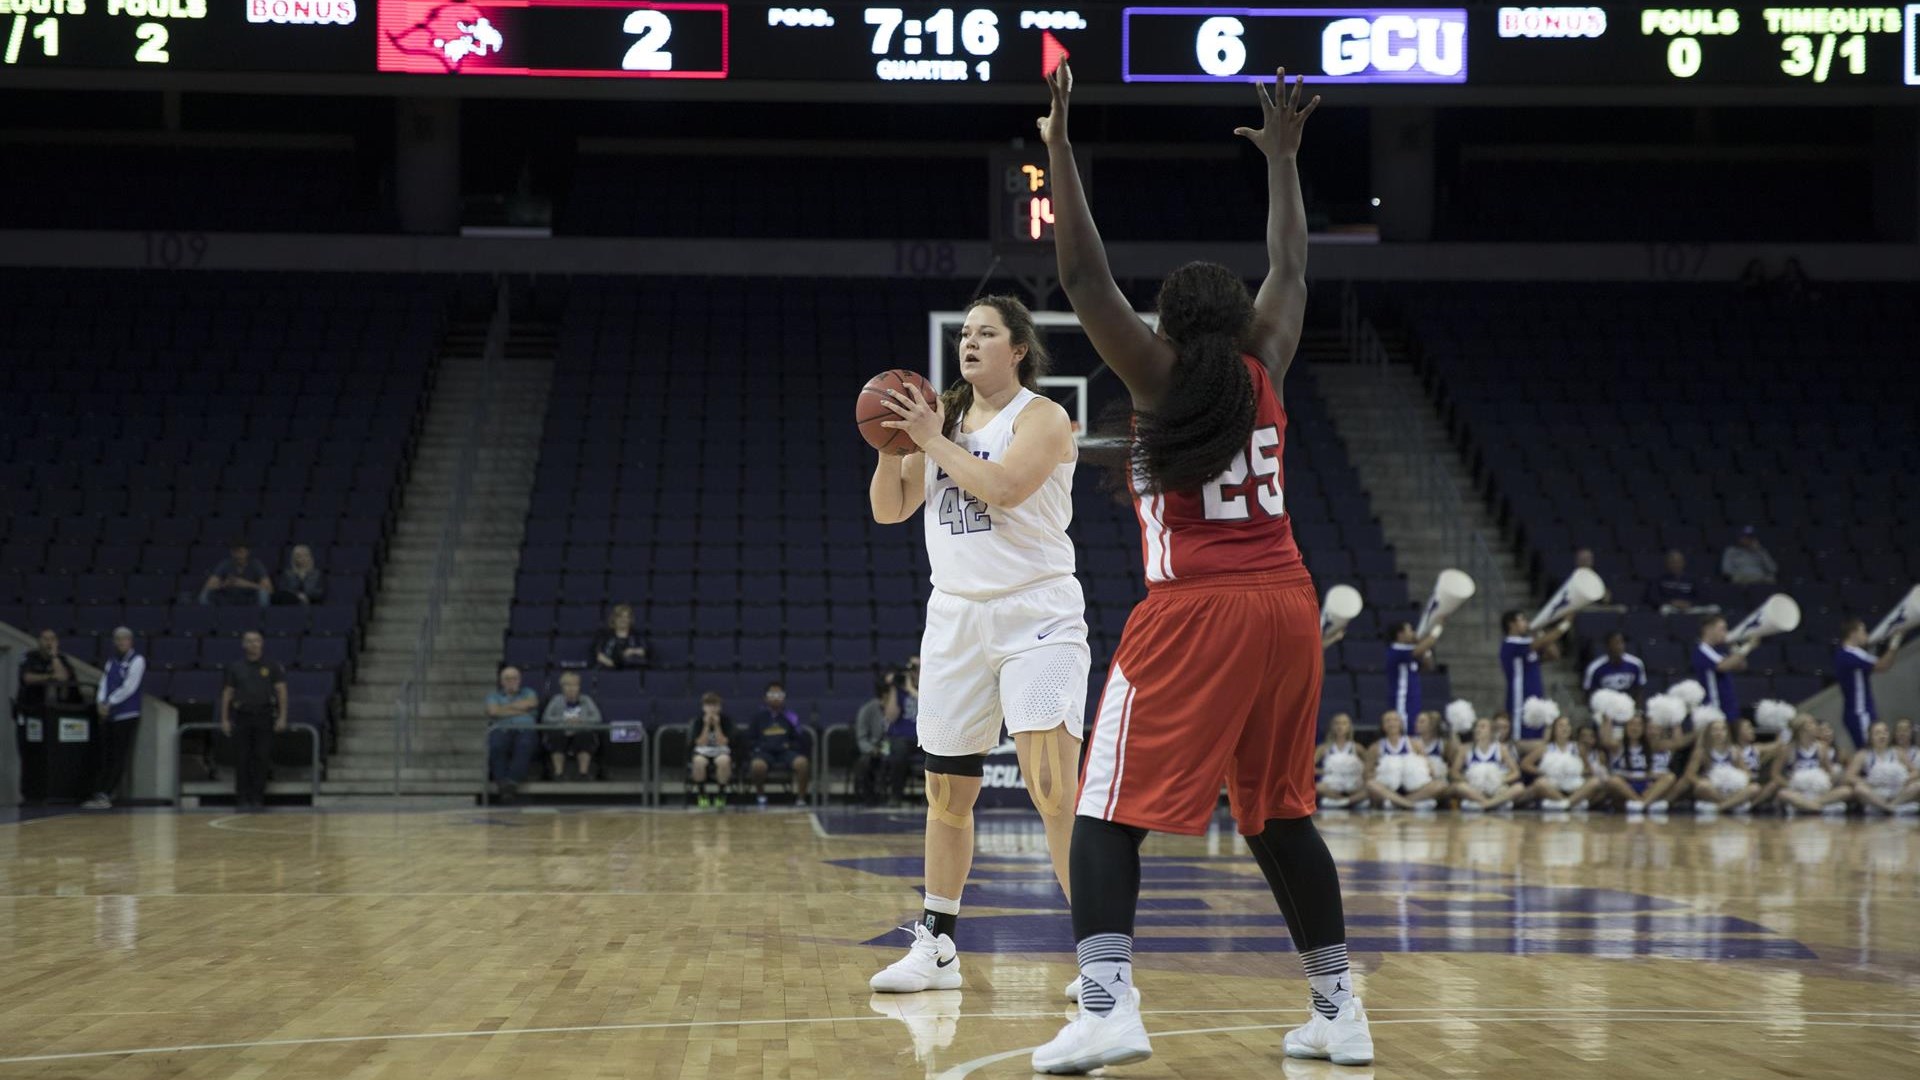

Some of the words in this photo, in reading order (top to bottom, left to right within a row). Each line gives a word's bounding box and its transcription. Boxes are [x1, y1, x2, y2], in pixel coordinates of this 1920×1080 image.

[247, 0, 356, 25] BONUS
[865, 8, 999, 55] 7:16
[1498, 7, 1607, 38] BONUS
[1641, 9, 1740, 35] FOULS
[1763, 8, 1902, 34] TIMEOUTS
[135, 22, 169, 63] 2
[622, 10, 672, 70] 2
[1196, 16, 1246, 76] 6
[1322, 15, 1465, 76] GCU
[1667, 37, 1701, 77] 0
[1781, 33, 1866, 82] 3/1
[876, 59, 968, 80] QUARTER
[975, 61, 990, 81] 1
[144, 231, 208, 267] 109
[894, 242, 957, 274] 108
[1647, 244, 1709, 276] 107
[1202, 426, 1284, 520] 25
[939, 486, 991, 535] 42
